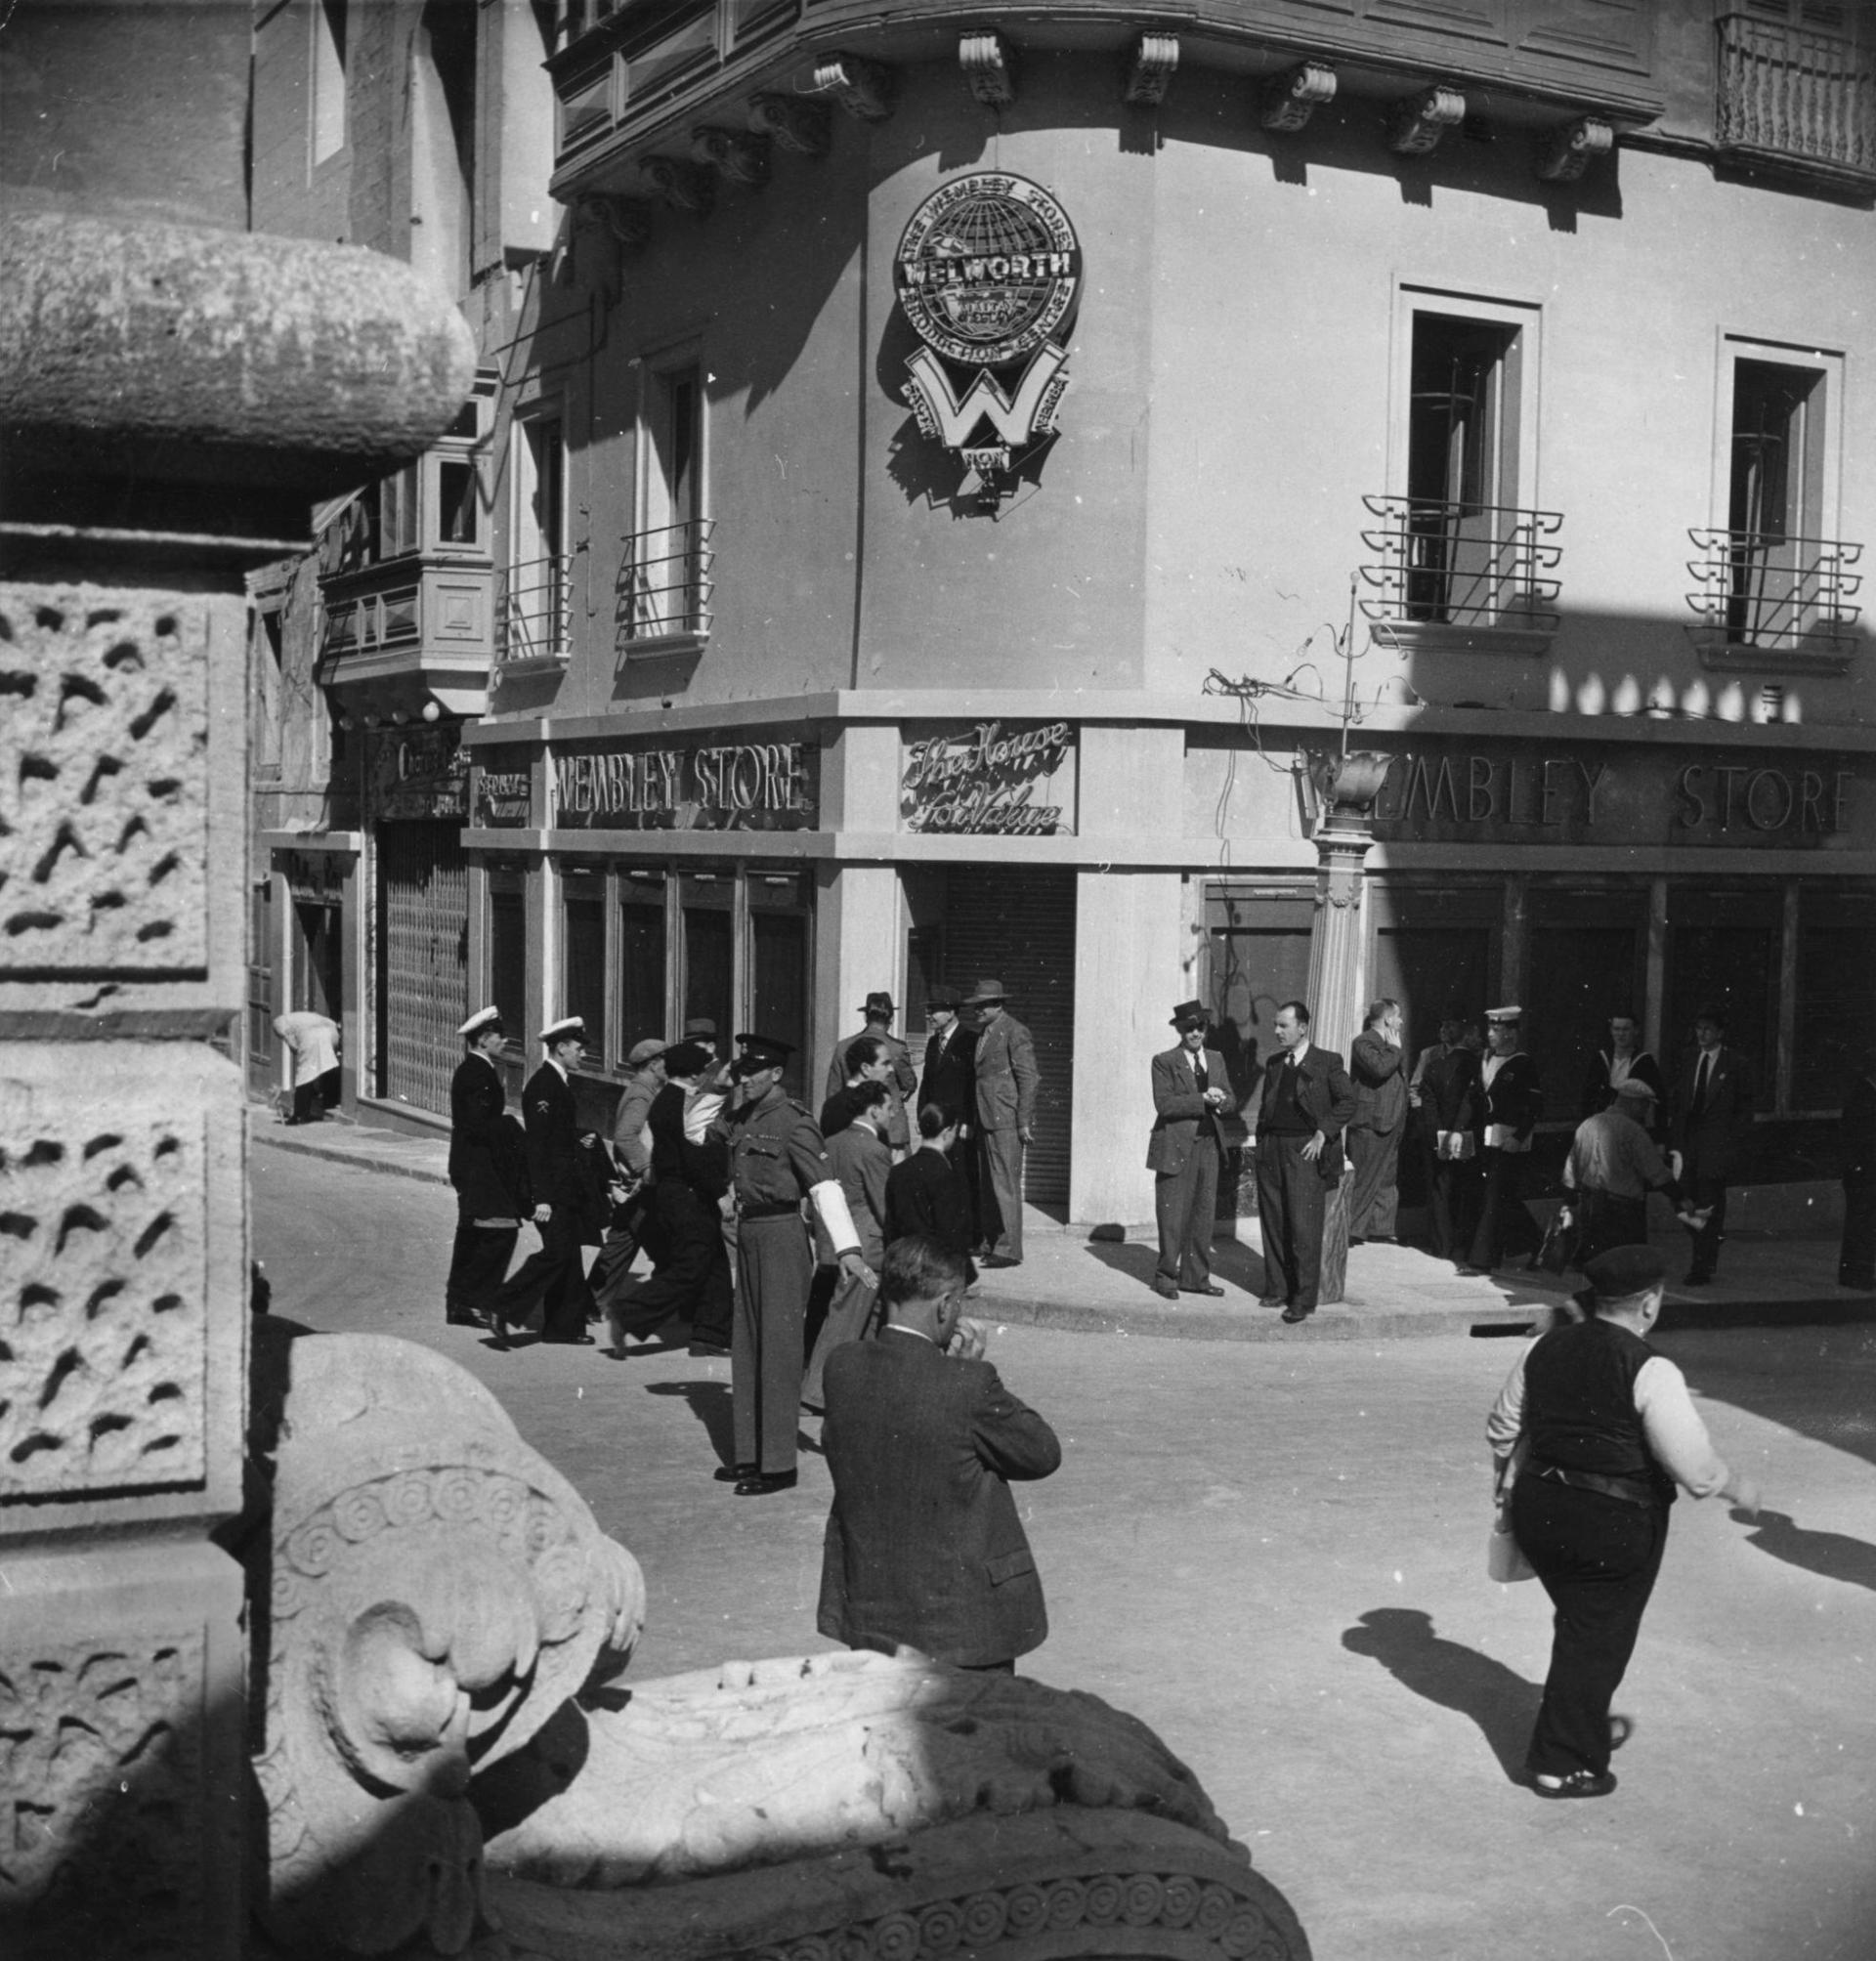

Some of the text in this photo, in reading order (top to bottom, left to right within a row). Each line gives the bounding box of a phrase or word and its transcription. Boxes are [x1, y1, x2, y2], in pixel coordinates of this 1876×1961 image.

[921, 177, 1017, 219] WEMBLEY
[904, 251, 1071, 284] WELWORTH
[902, 292, 1003, 362] PRODUCTION
[903, 338, 1071, 449] W
[552, 743, 804, 812] WEMBLEY STORE
[902, 718, 1073, 790] The House
[971, 781, 1064, 827] Value
[1681, 764, 1855, 831] STORE
